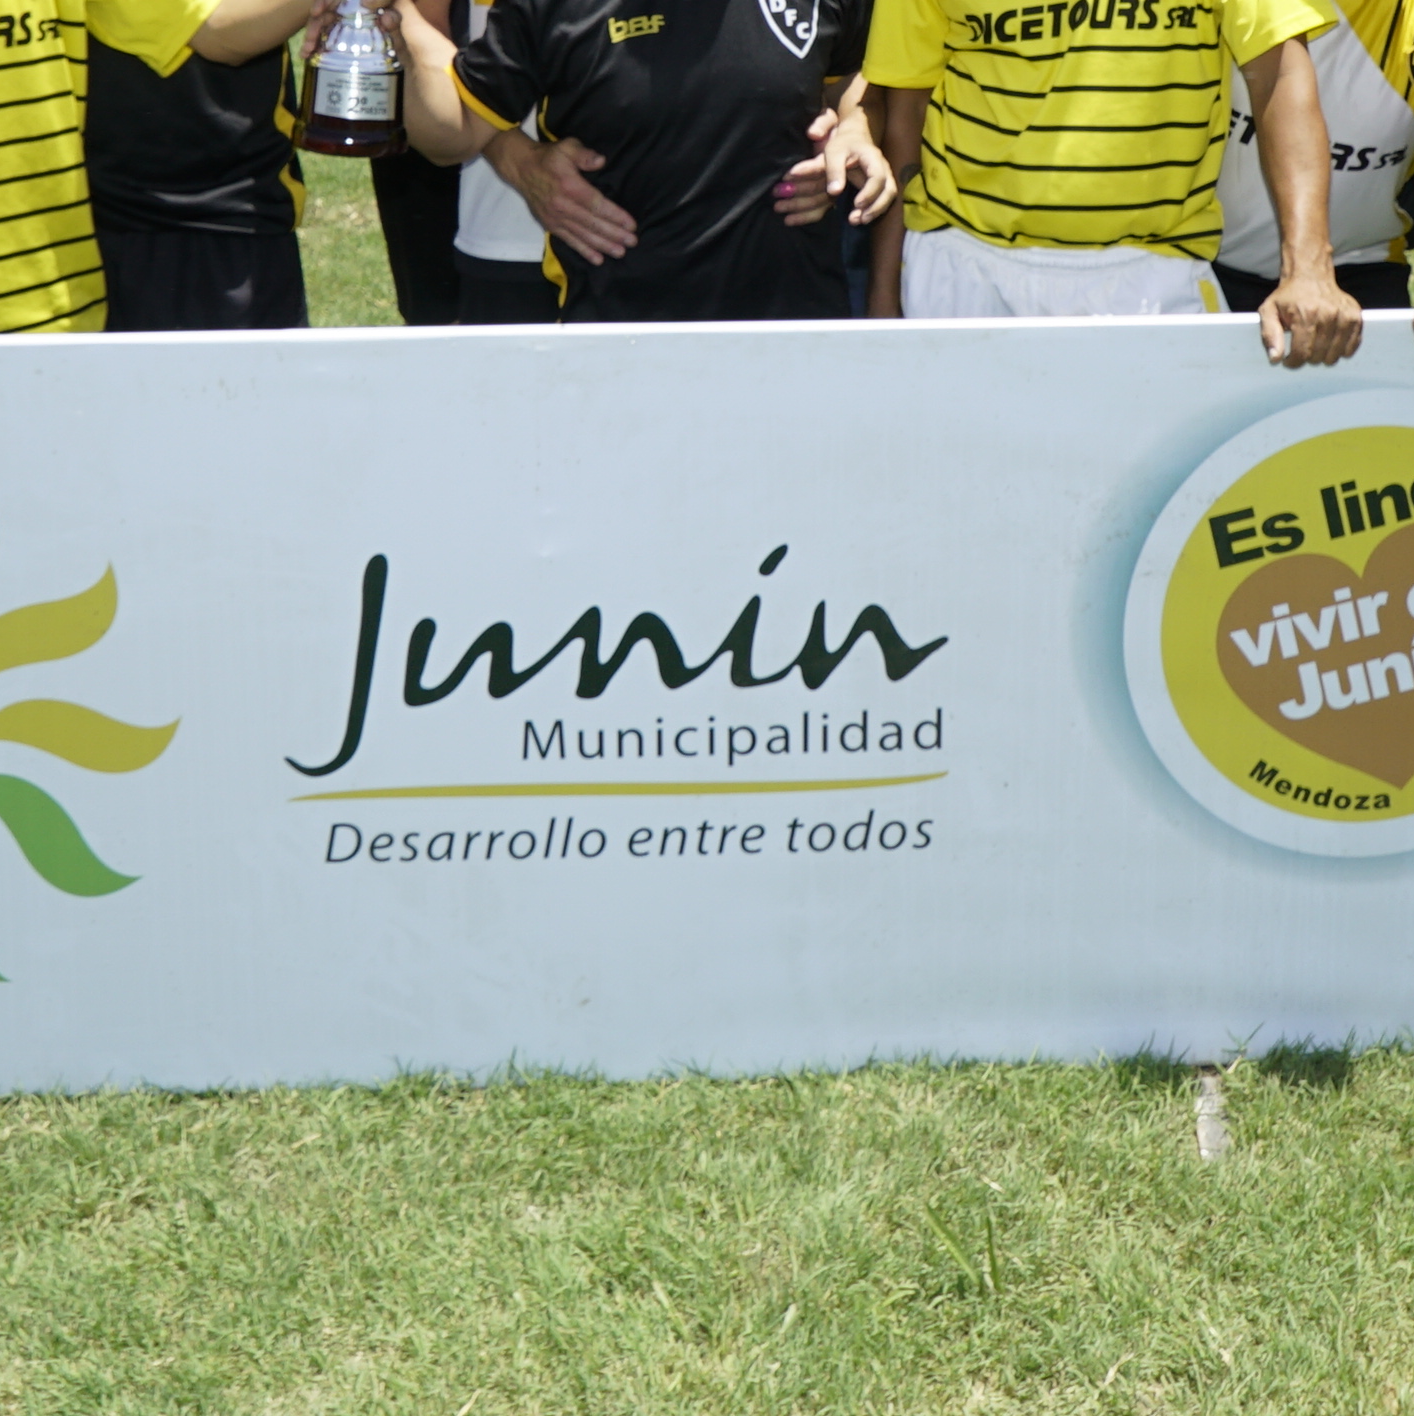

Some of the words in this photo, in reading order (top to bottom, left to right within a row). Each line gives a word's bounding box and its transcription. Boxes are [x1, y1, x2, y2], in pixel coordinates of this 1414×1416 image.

[1208, 507, 1305, 569] Es
[1229, 586, 1389, 667] vivir
[284, 544, 949, 777] Junín
[522, 708, 943, 766] Municipalidad
[1248, 759, 1392, 812] Mendoza
[324, 817, 608, 864] Desarrollo
[626, 819, 766, 857] entre
[786, 809, 935, 853] todos
